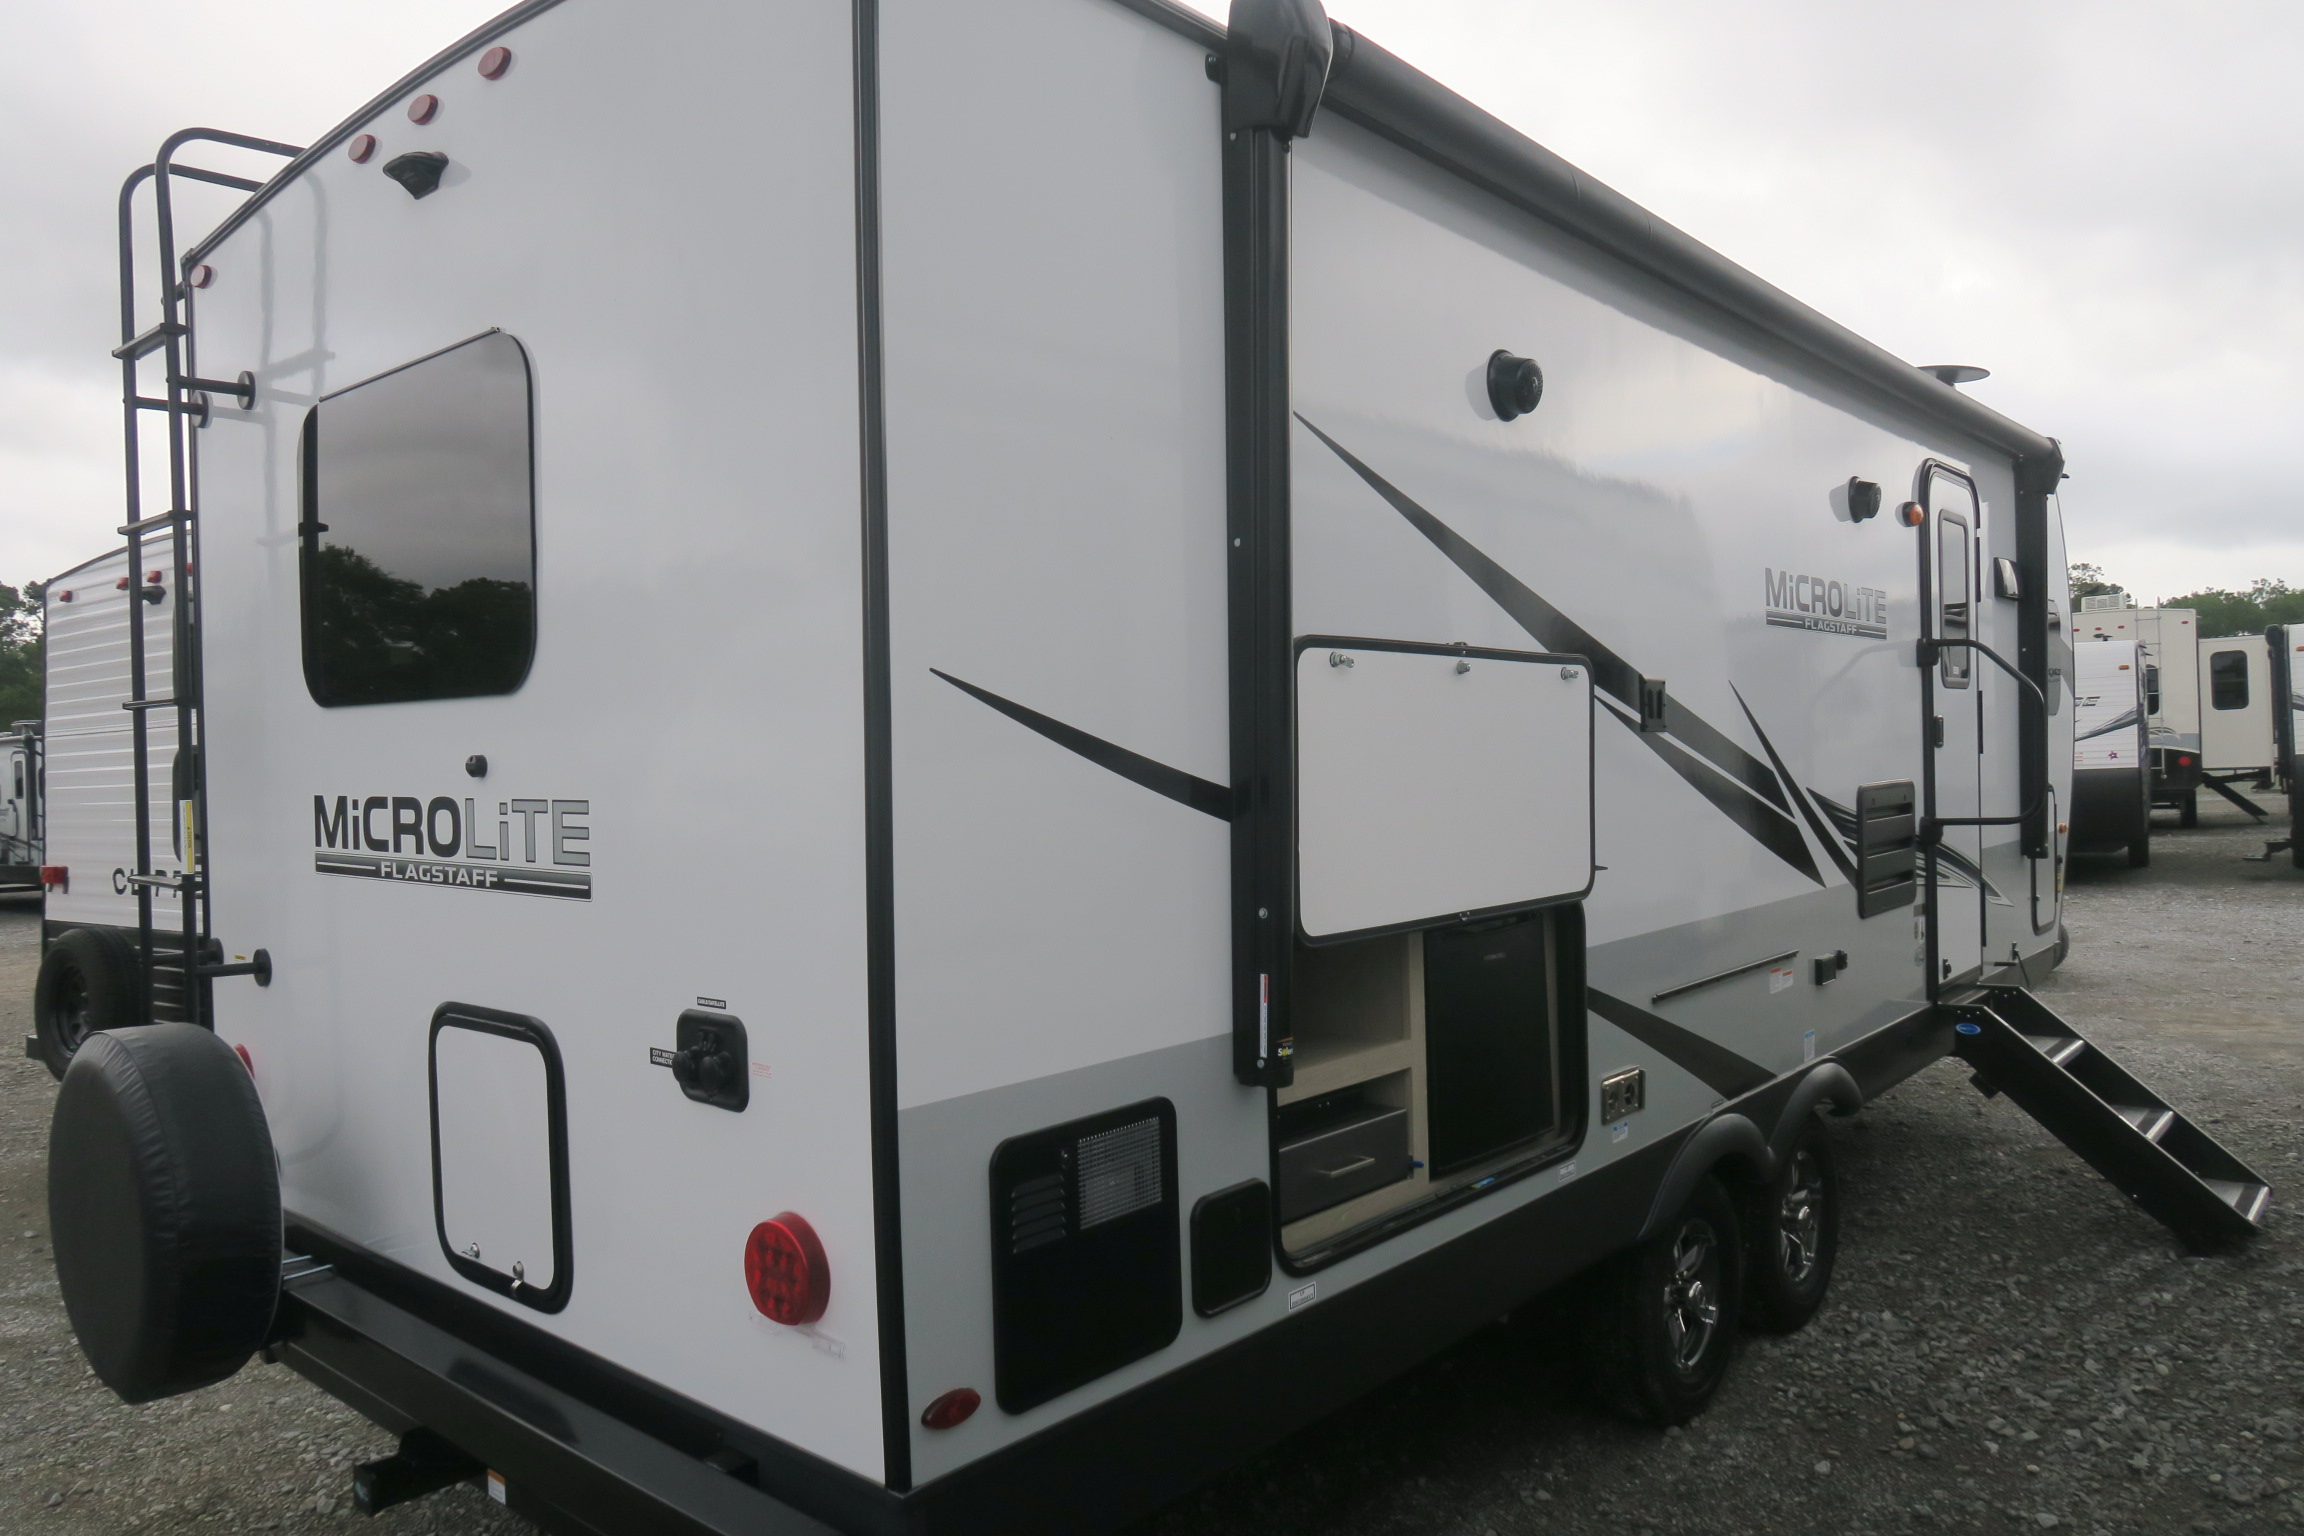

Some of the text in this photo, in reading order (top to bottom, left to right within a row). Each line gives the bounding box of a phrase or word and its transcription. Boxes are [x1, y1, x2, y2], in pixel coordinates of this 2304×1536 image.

[1804, 618, 1857, 635] FLAGSTAFF
[380, 860, 498, 888] FLAGSTAFF
[652, 1049, 661, 1057] CITY
